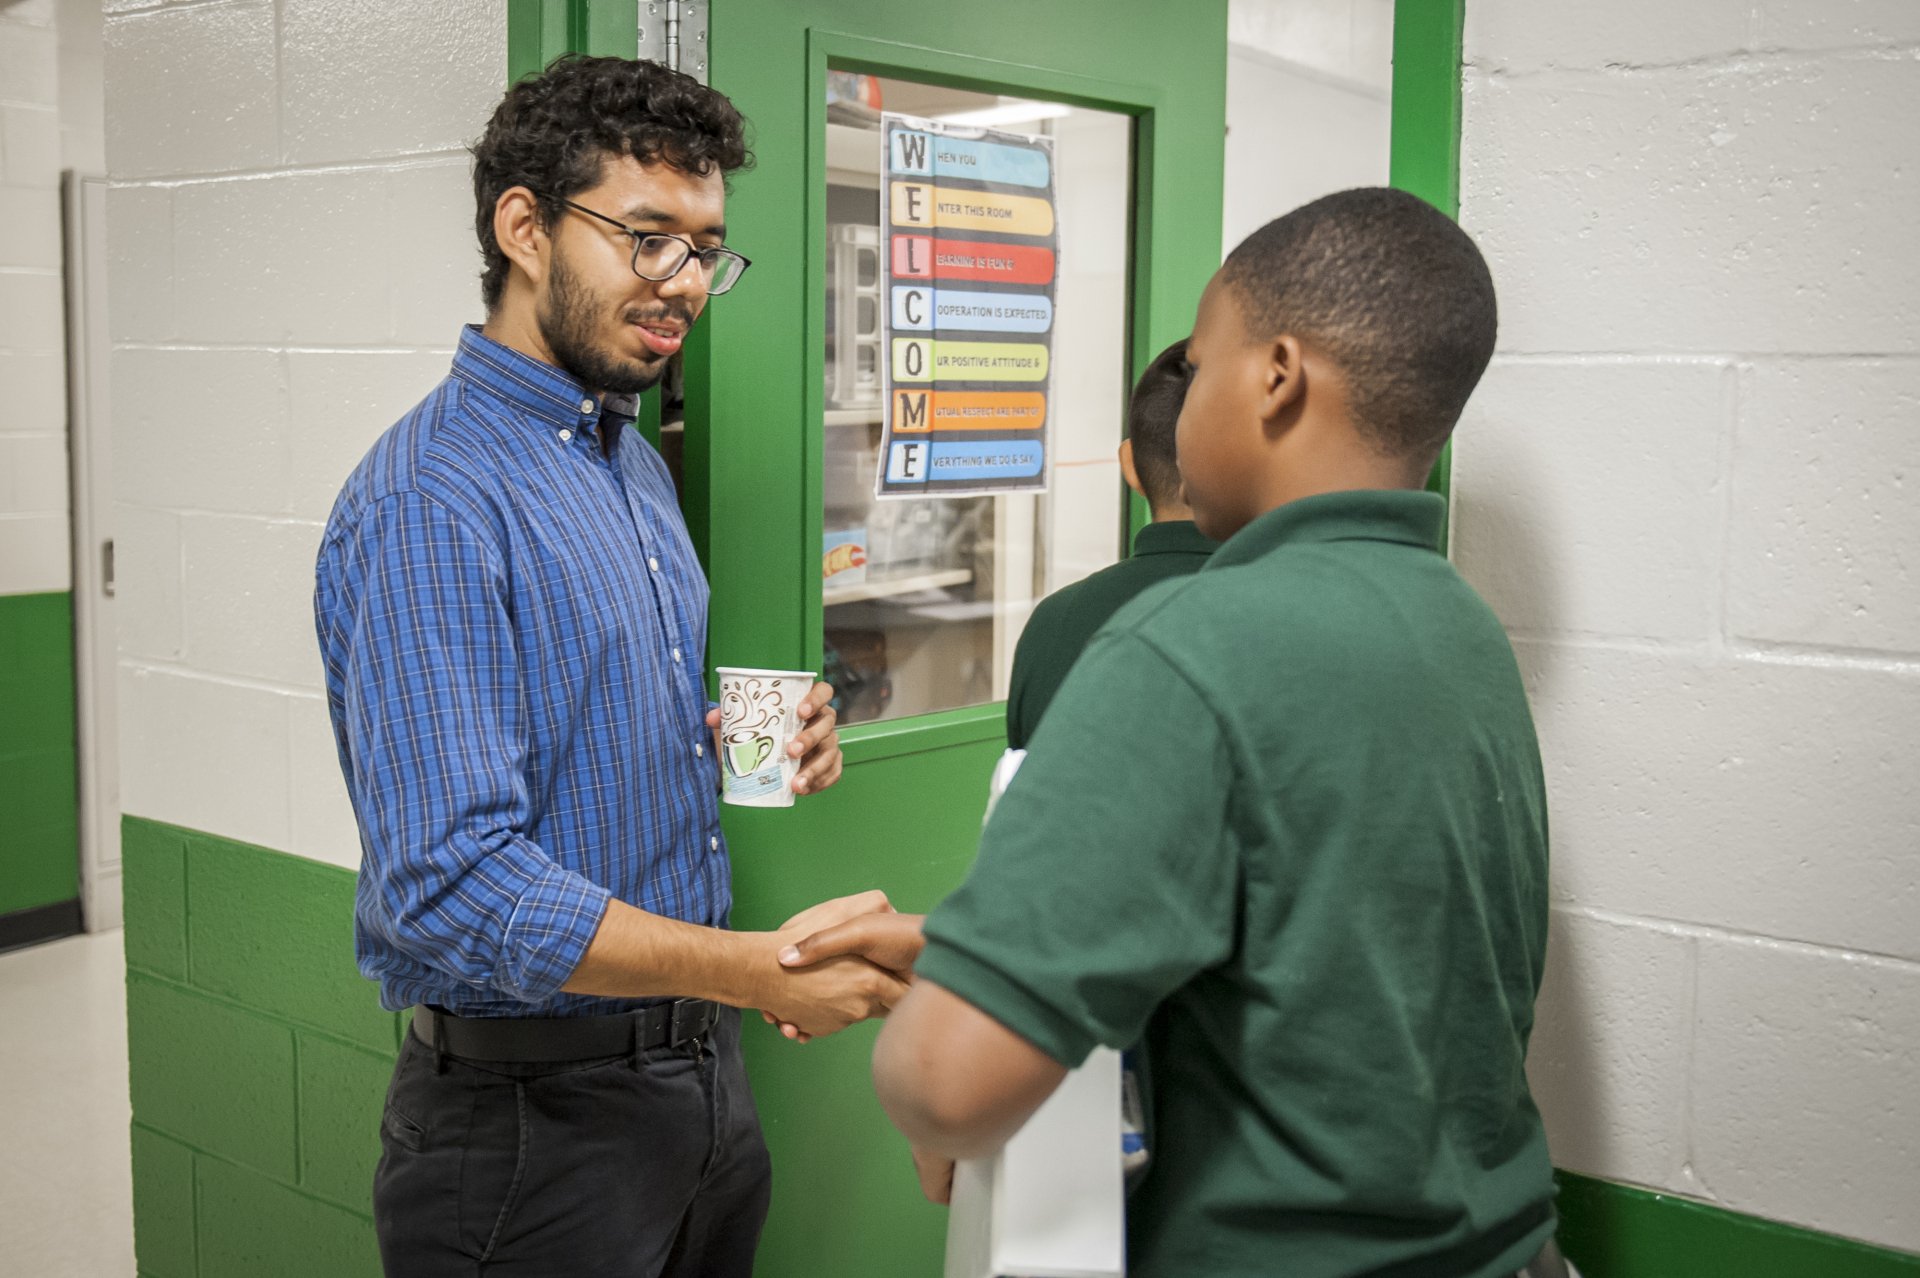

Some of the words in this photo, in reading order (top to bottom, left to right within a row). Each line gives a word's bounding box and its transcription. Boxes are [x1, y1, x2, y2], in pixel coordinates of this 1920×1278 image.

[898, 134, 926, 170] W
[937, 152, 956, 166] HEN
[958, 153, 977, 166] YOU
[905, 186, 921, 222] E
[937, 203, 962, 215] NTER
[964, 205, 985, 216] THIS
[987, 207, 1012, 219] ROOM
[906, 238, 920, 274] L
[904, 290, 922, 325] C
[937, 304, 992, 318] OOPERATION
[994, 307, 1003, 318] IS
[905, 342, 922, 376] O
[937, 356, 949, 366] UR
[951, 356, 989, 368] POSITIVE
[991, 357, 1031, 368] ATTITUDE
[900, 393, 926, 427] M
[903, 444, 918, 477] E
[933, 456, 982, 468] VERYTHING
[984, 455, 997, 466] WE
[999, 455, 1010, 465] DO
